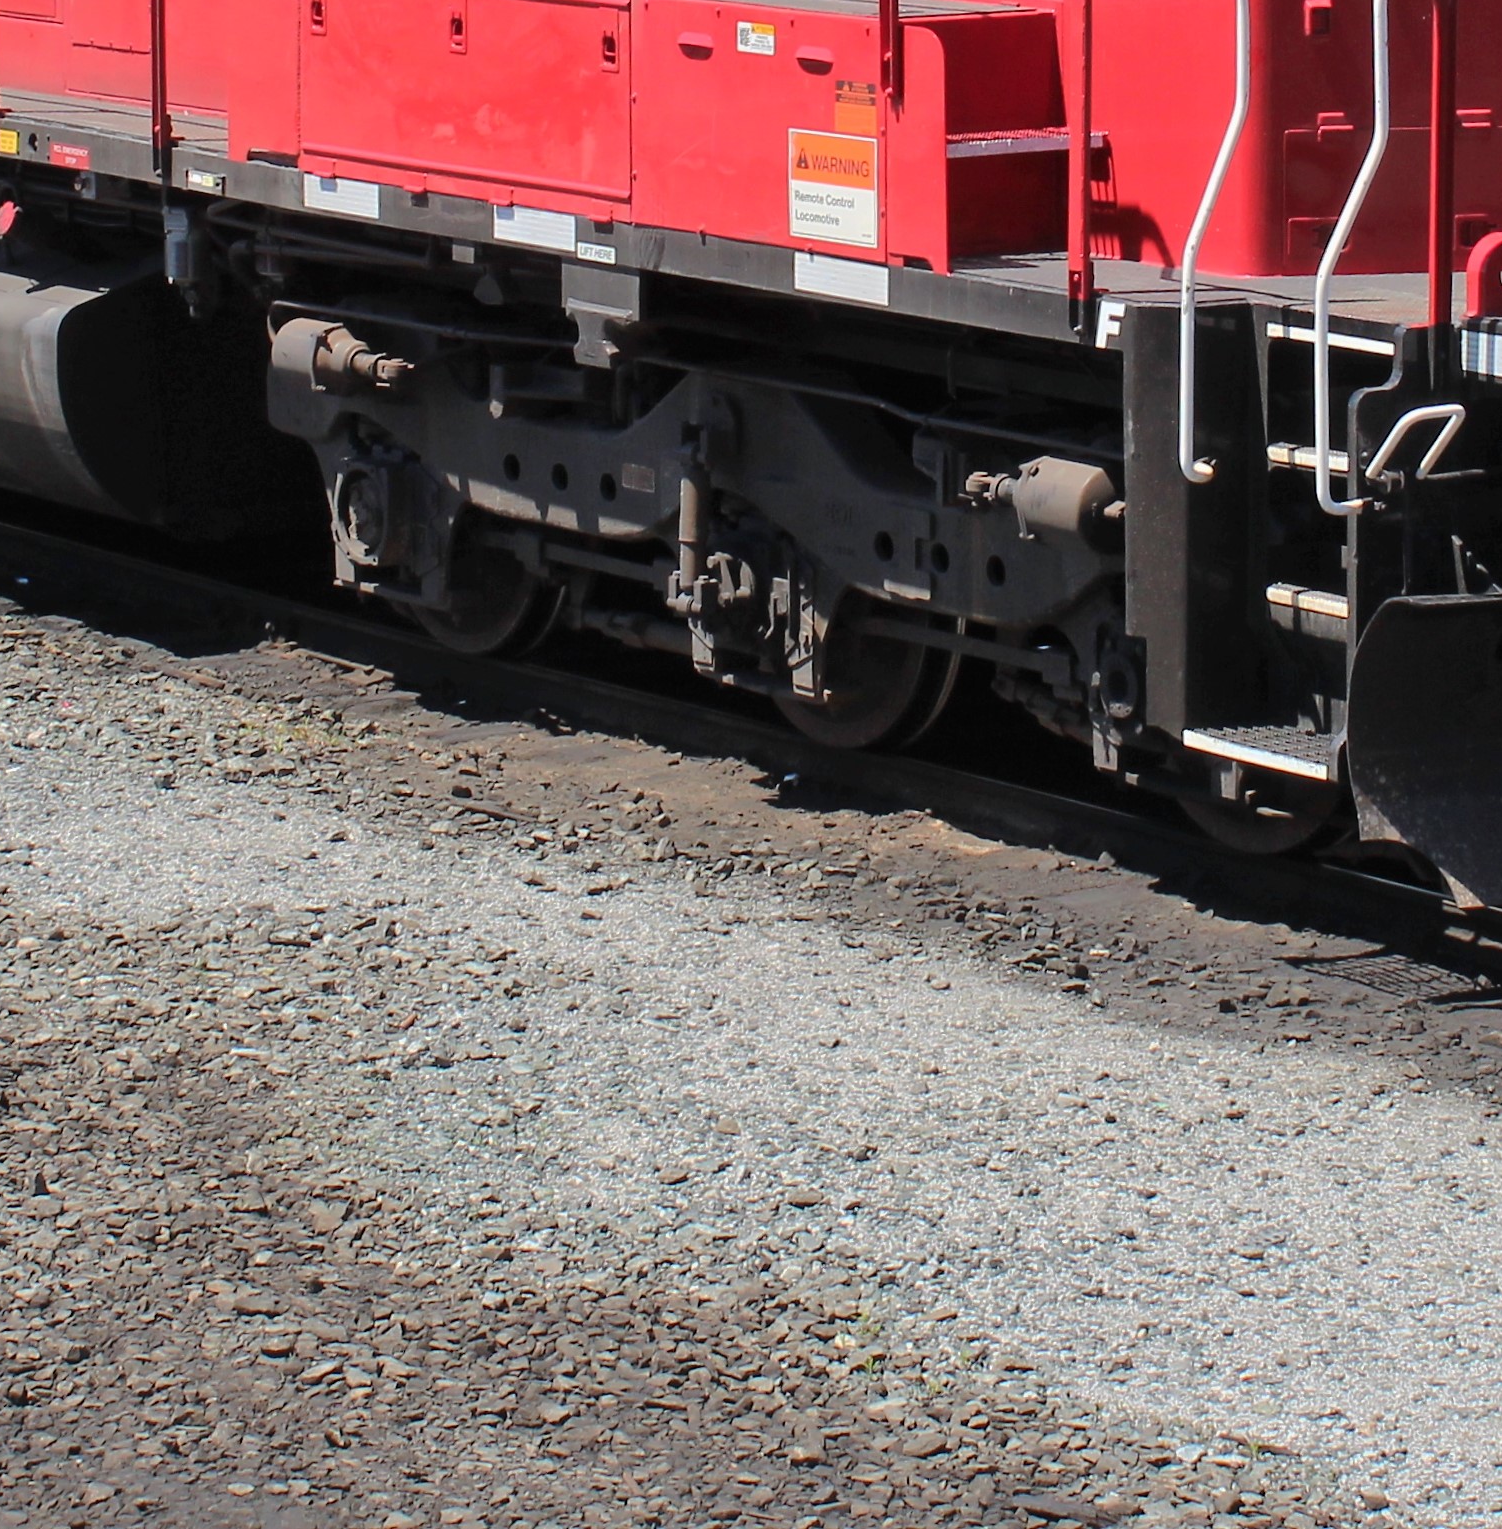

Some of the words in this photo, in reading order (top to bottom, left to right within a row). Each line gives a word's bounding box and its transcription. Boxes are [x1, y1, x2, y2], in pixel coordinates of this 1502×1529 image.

[811, 154, 870, 178] WARNING
[794, 190, 824, 205] Remote
[825, 194, 855, 209] Control
[795, 209, 840, 226] Locomotive
[580, 245, 594, 258] LIFT
[594, 247, 614, 261] HERE
[1095, 300, 1126, 349] F
